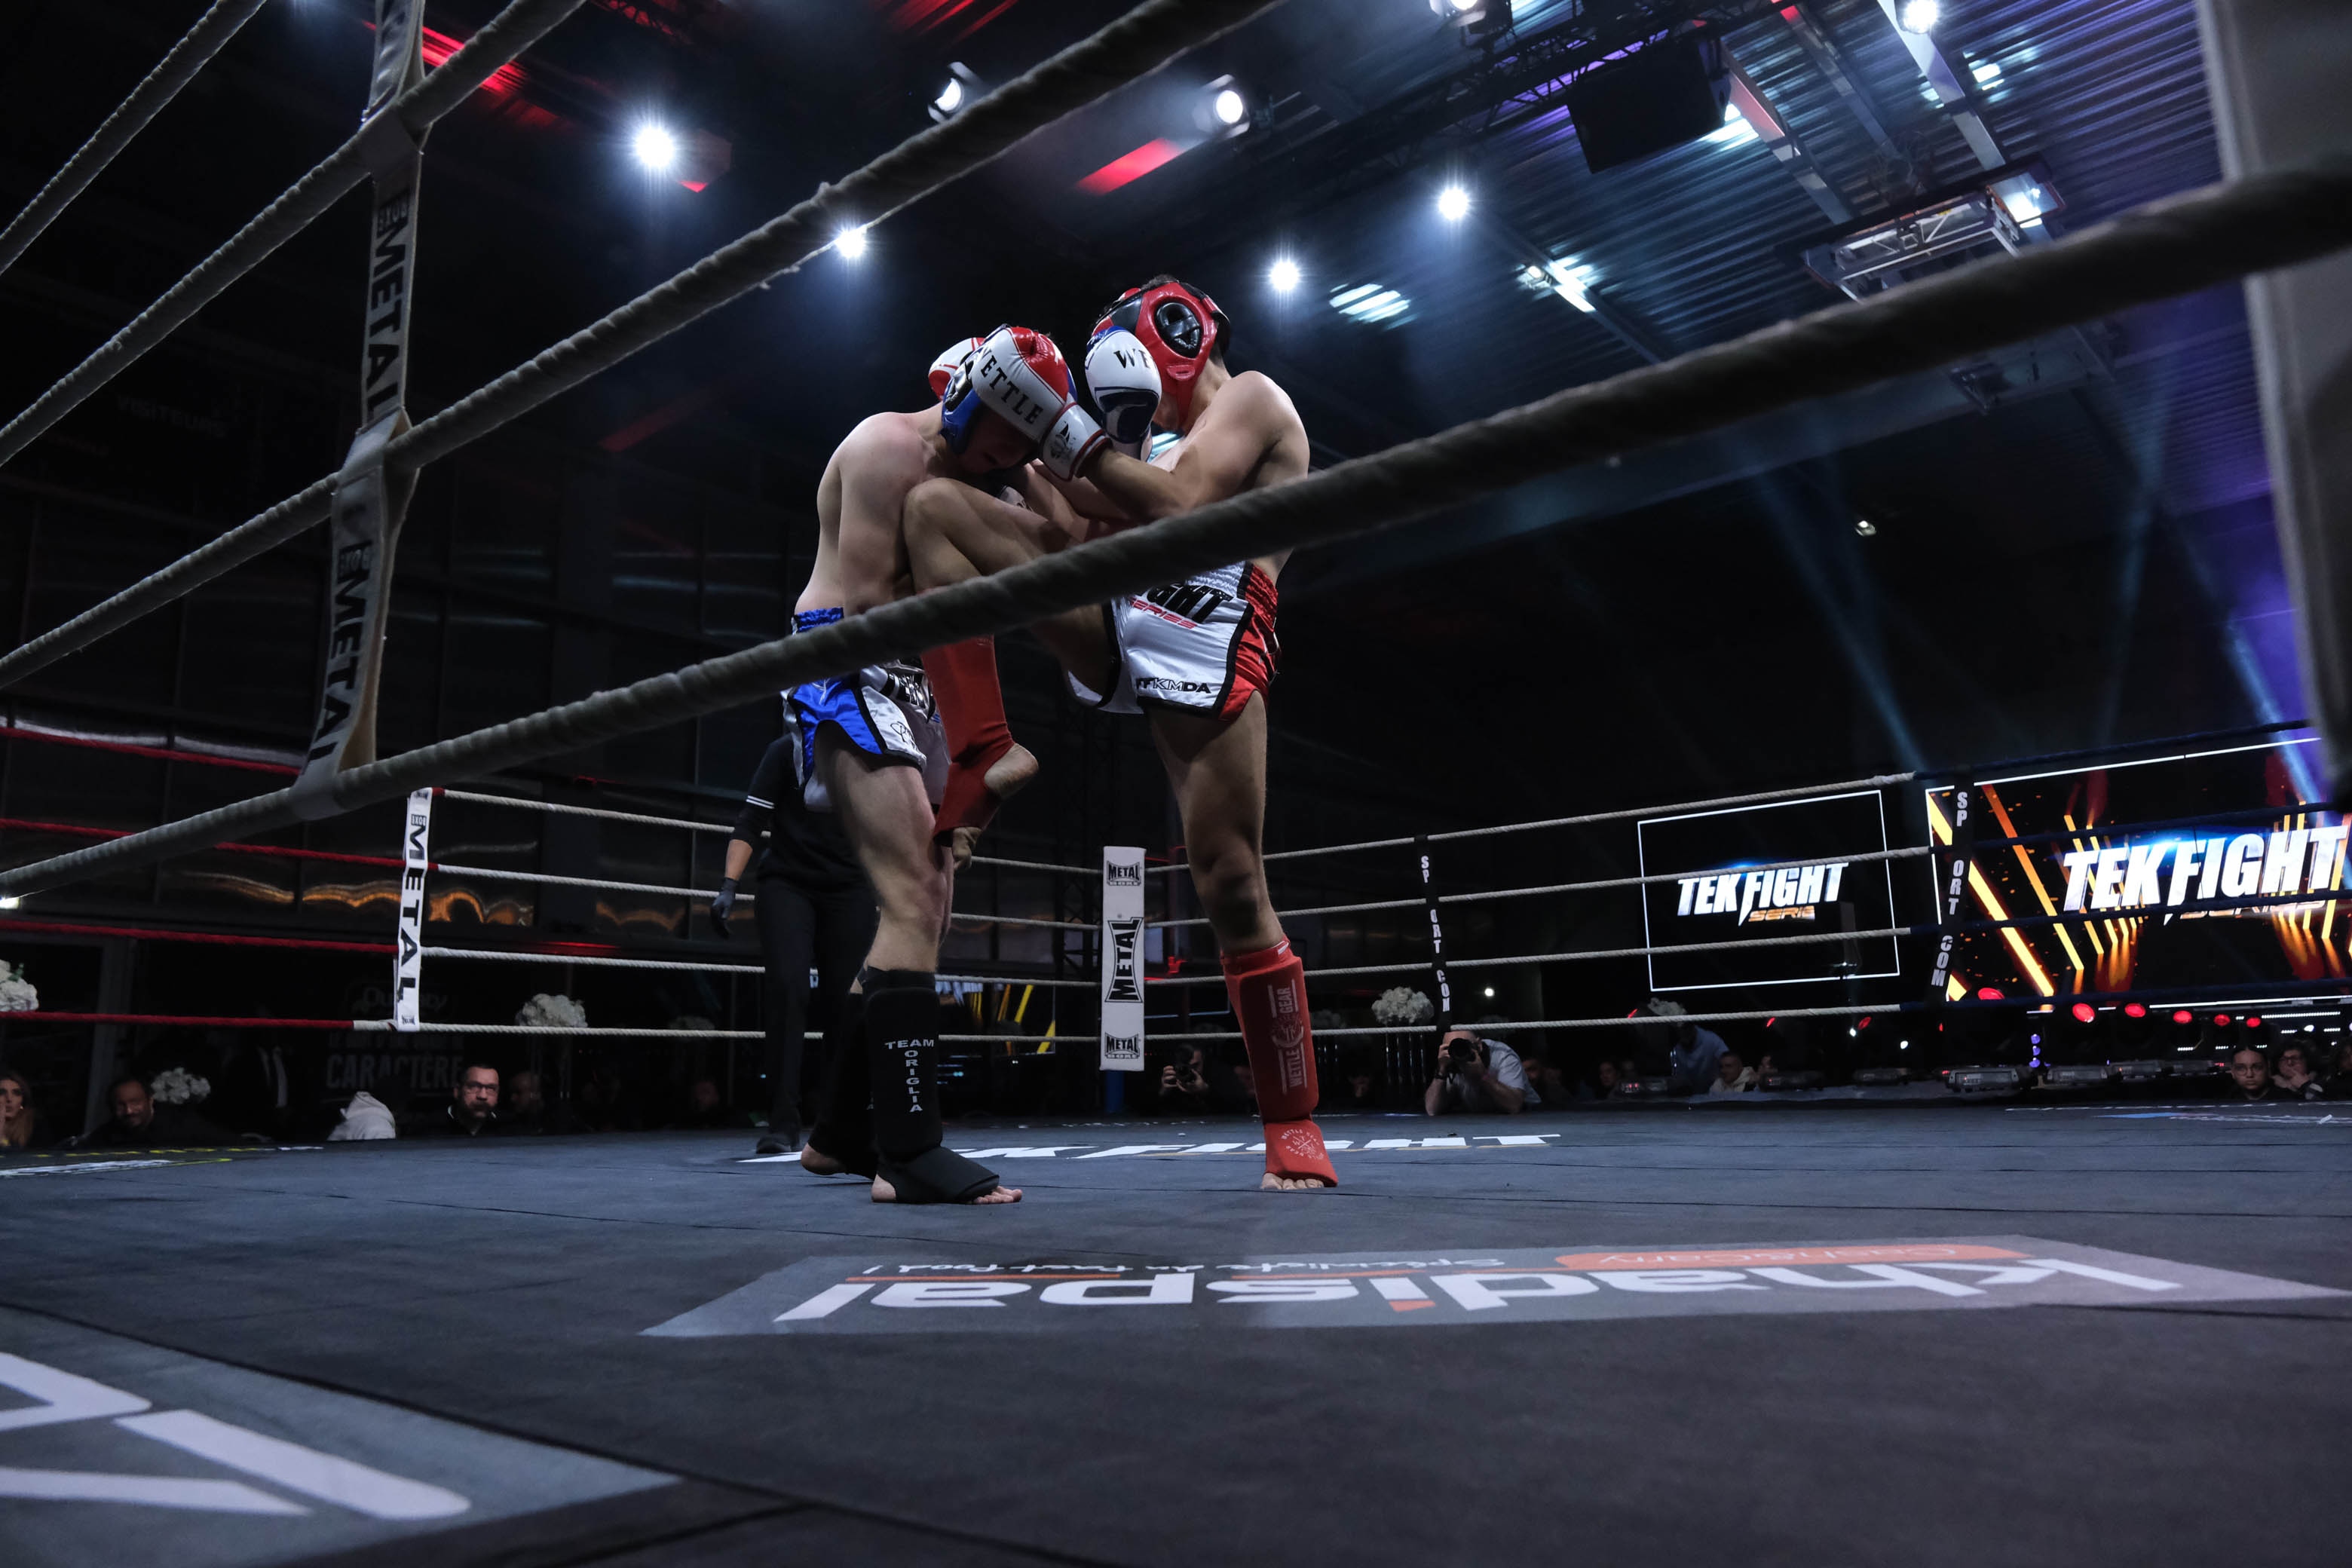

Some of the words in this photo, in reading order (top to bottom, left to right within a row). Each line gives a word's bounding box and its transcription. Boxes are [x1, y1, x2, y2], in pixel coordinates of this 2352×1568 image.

[366, 222, 408, 427] METAL
[1108, 864, 1140, 880] METAL
[1677, 873, 1742, 916] TEK
[1738, 862, 1849, 926] FIGHT
[2063, 842, 2169, 911] TEK
[2164, 825, 2349, 926] FIGHT
[397, 825, 426, 1003] METAL
[1108, 919, 1141, 1000] METAL
[1277, 986, 1294, 1014] GEAR
[884, 1039, 934, 1049] TEAM
[1107, 1036, 1138, 1053] METAL
[1285, 1047, 1303, 1088] WETTLE
[905, 1050, 923, 1113] ORIGLIA
